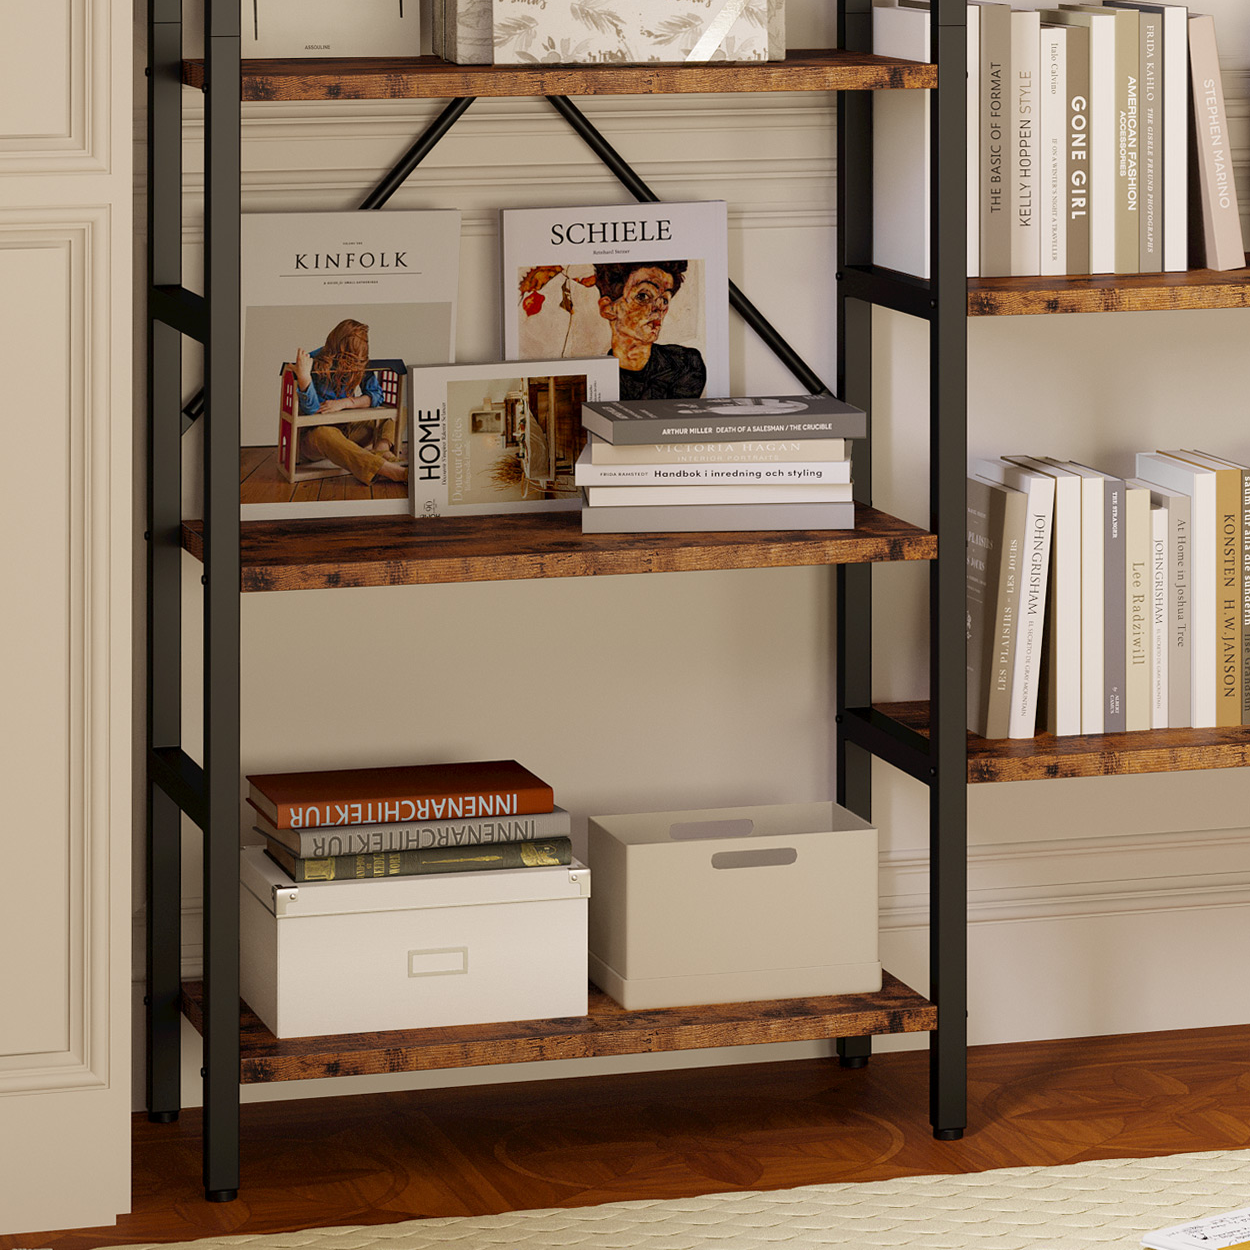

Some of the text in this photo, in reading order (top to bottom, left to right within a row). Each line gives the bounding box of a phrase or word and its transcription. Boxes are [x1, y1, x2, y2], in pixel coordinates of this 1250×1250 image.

[991, 62, 1001, 213] THE BASIC OF FORMAT
[1020, 71, 1032, 227] KELLY HOPPEN STYLE
[1072, 96, 1086, 220] GONE GIRL
[1128, 76, 1136, 211] AMERICAN FASHION
[1204, 79, 1230, 209] STEPHEN MARINO
[295, 252, 408, 270] KINFOLK
[551, 220, 673, 246] SCHIELE
[419, 409, 441, 481] HOME
[655, 444, 733, 453] VICTORIA
[662, 428, 688, 436] ARTHUR
[690, 427, 713, 435] MILLER
[752, 425, 785, 433] SALESMAN
[802, 423, 832, 431] CRUCIBLE
[654, 470, 701, 478] Handbok
[712, 470, 762, 479] inredning
[766, 469, 785, 477] och
[788, 469, 823, 479] styling
[1007, 539, 1018, 594] LES JOURS
[1174, 519, 1187, 648] At Home in Joshua Tree
[1224, 514, 1235, 587] KONSTEN
[998, 607, 1012, 691] LES PLAISIRS
[1133, 562, 1145, 666] Lee Radziwill
[290, 794, 518, 828] INNENARCHITEKTUR
[313, 820, 536, 857] INNENARCHITEKTUR
